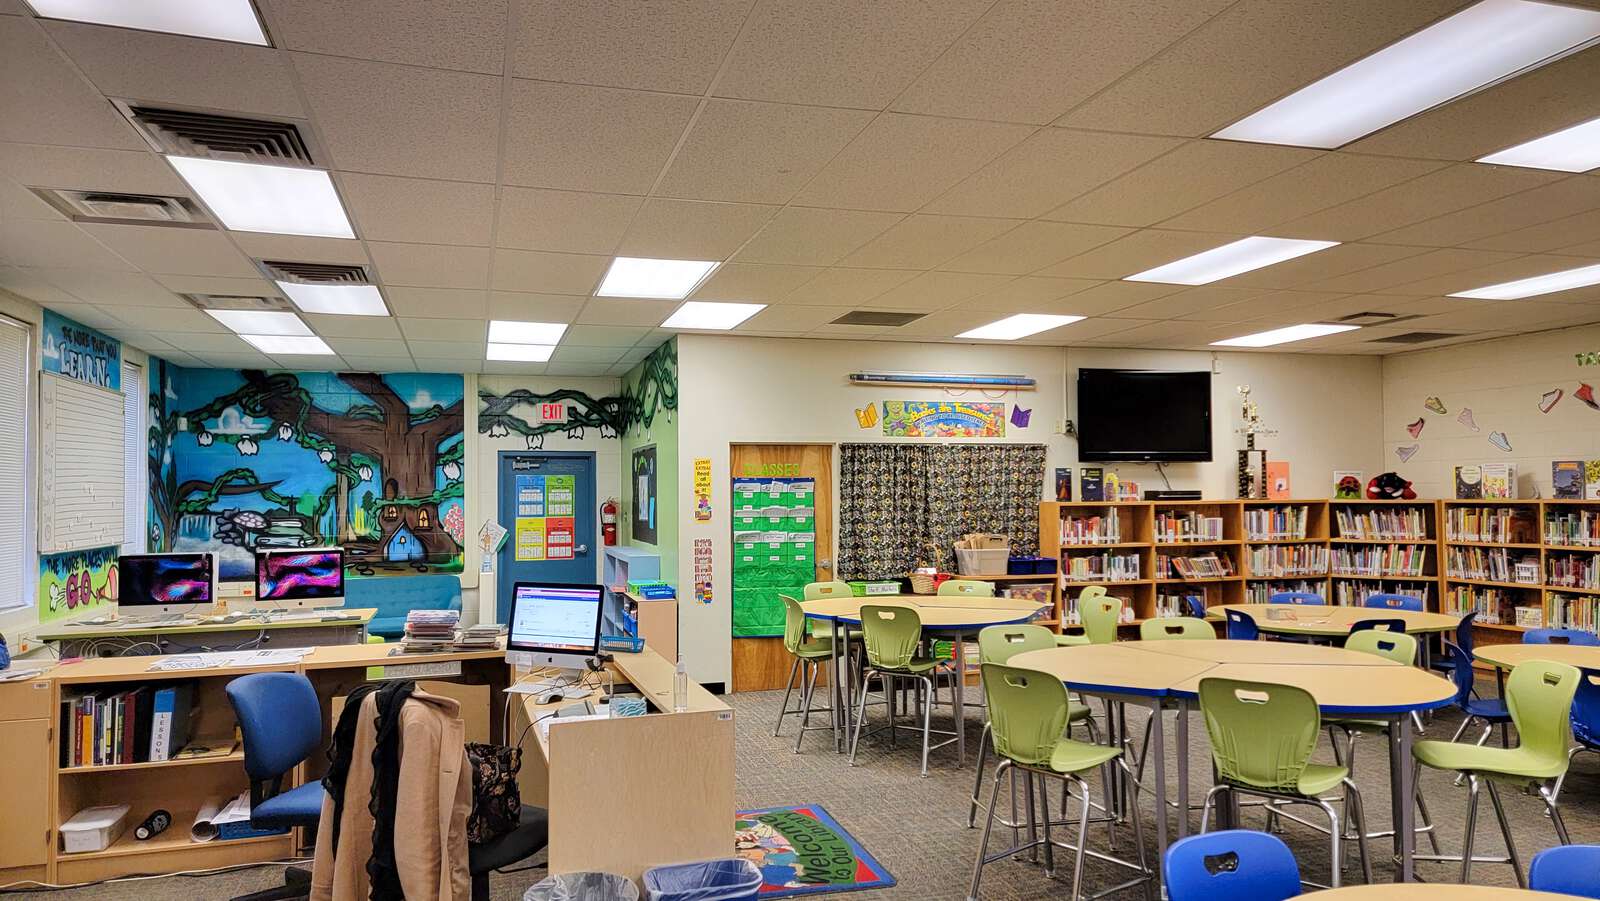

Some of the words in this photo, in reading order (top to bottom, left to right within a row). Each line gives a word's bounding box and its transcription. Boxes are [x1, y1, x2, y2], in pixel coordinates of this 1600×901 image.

[543, 404, 563, 420] EXIT
[911, 407, 936, 421] Books
[939, 404, 952, 413] are
[66, 569, 92, 610] GO
[785, 812, 837, 842] Library
[758, 814, 831, 884] Welcome
[832, 868, 852, 881] to
